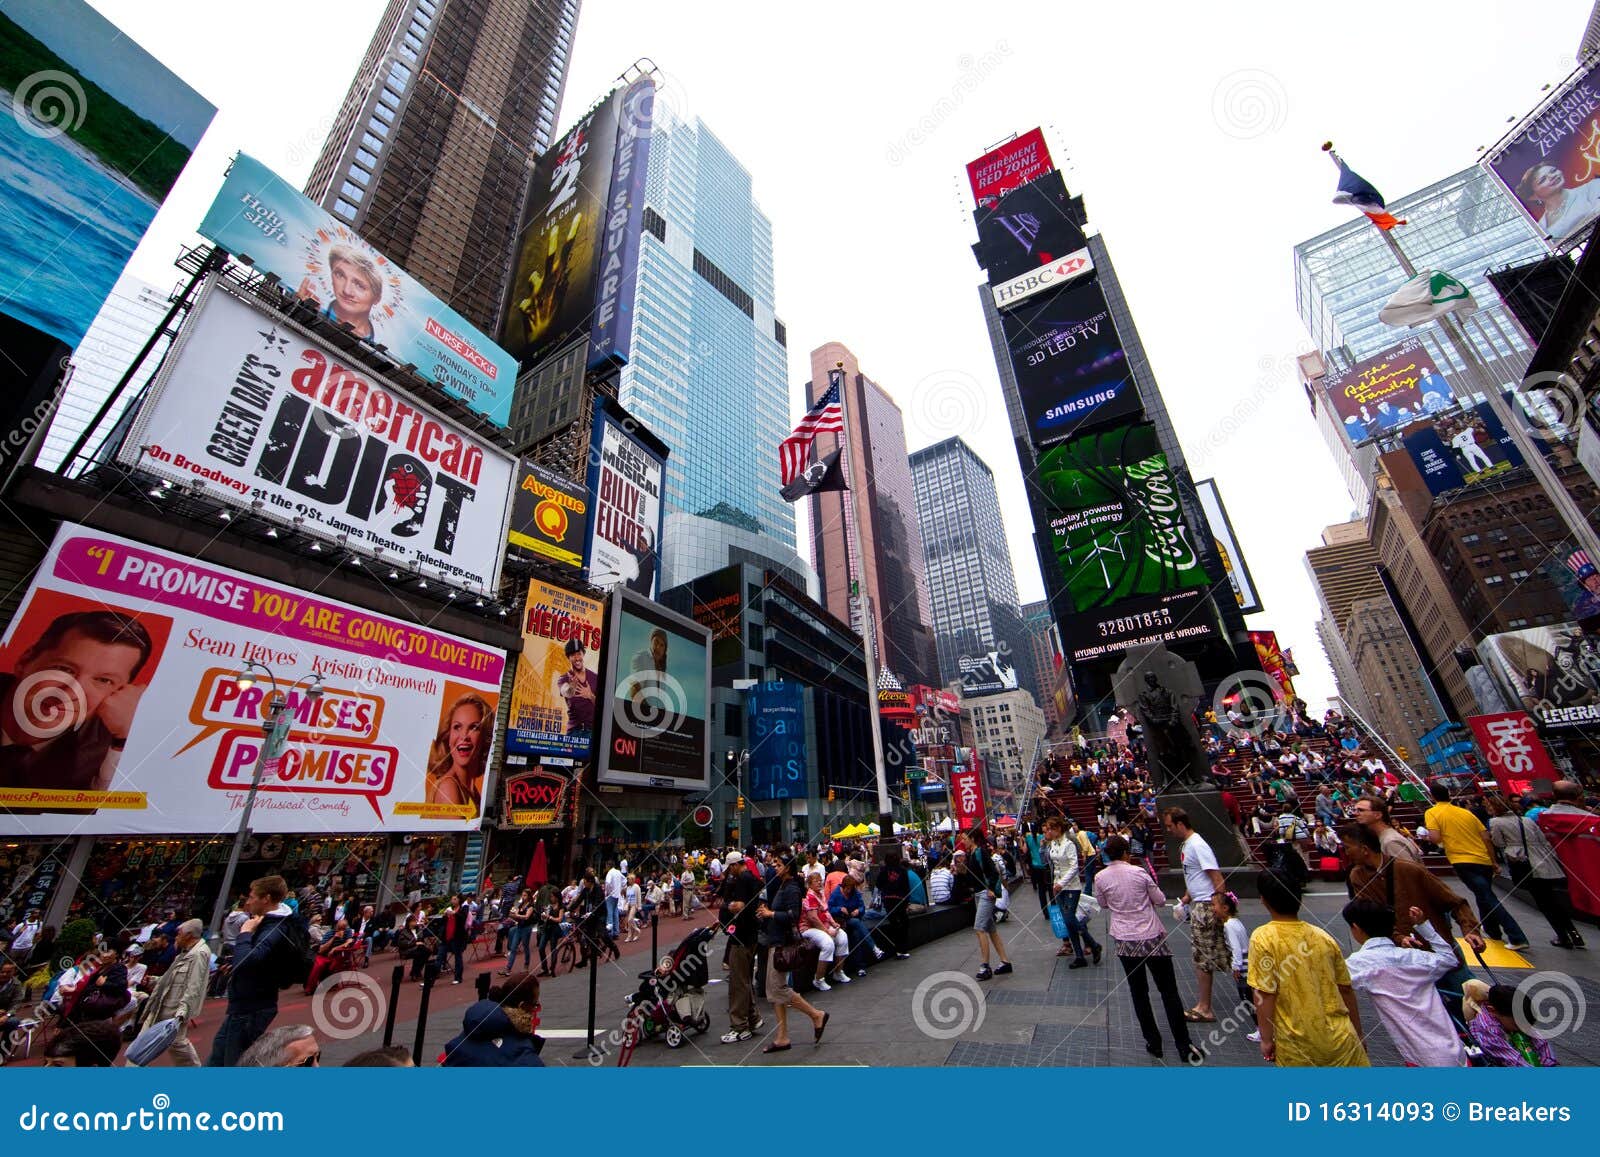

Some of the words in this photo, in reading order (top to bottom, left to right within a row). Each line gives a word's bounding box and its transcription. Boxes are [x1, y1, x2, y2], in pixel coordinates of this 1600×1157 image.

[1527, 83, 1594, 143] CATHERINE
[976, 141, 1038, 180] RETIREMENT
[979, 170, 1003, 190] RED
[1005, 151, 1038, 176] ZONE
[1016, 162, 1041, 180] .com
[544, 160, 581, 217] 2
[239, 191, 284, 229] Holy
[243, 212, 287, 246] shift.
[597, 190, 629, 325] SQUARE
[999, 269, 1055, 301] HSBC
[1027, 351, 1046, 367] 3D
[1048, 336, 1076, 356] LED
[1078, 323, 1099, 340] TV
[1053, 324, 1084, 343] WORLD'S
[1085, 310, 1108, 327] FIRST
[427, 320, 463, 353] NURSE
[464, 347, 497, 378] JACKIE
[437, 351, 478, 386] MONDAYS
[229, 353, 281, 419] DAY'S
[432, 363, 478, 401] SHOWTIME
[1344, 363, 1416, 398] Addams
[1354, 377, 1418, 403] Family
[1358, 363, 1390, 379] The
[291, 348, 484, 486] american
[1045, 389, 1116, 420] SAMSUNG
[206, 402, 264, 468] GREEN
[254, 393, 476, 556] IDIOT
[602, 448, 659, 499] MUSICAL
[618, 444, 649, 476] BEST
[522, 474, 585, 515] Avenue
[600, 466, 640, 520] BILLY
[148, 444, 171, 463] On
[173, 451, 250, 495] Broadway
[251, 487, 268, 502] at
[270, 491, 293, 510] the
[309, 507, 324, 523] St.
[325, 514, 365, 540] James
[366, 526, 406, 555] Theatre
[415, 549, 484, 585] Telecharge.com
[534, 500, 568, 543] Q
[596, 501, 646, 553] ELLIOT
[1050, 512, 1080, 528] display
[1083, 502, 1123, 517] powered
[1055, 527, 1066, 536] by
[1067, 518, 1089, 532] wind
[1090, 512, 1123, 525] energy
[118, 553, 250, 611] PROMISE
[248, 588, 299, 623] YOU
[300, 604, 342, 635] ARE
[347, 617, 403, 651] GOING
[406, 632, 429, 656] TO
[430, 641, 468, 667] LOVE
[535, 602, 549, 612] IN
[550, 606, 571, 617] THE
[526, 607, 602, 652] HEIGHTS
[1074, 646, 1106, 660] HYUNDAI
[1106, 638, 1138, 653] OWNERS
[1139, 633, 1162, 646] CAN'T
[1164, 631, 1177, 641] BE
[1177, 624, 1211, 640] WRONG.
[183, 626, 237, 661] Sean
[241, 640, 299, 668] Hayes
[311, 654, 363, 682] Kristin
[366, 663, 437, 697] Chenoweth
[208, 679, 373, 736] PROMISES,
[545, 719, 562, 733] BLEU
[227, 743, 386, 787] POMISES
[614, 738, 636, 757] CNN
[1486, 718, 1534, 773] tkts
[225, 791, 252, 811] The
[253, 797, 305, 811] Musical
[307, 796, 352, 817] Comedy
[960, 775, 978, 814] tkts
